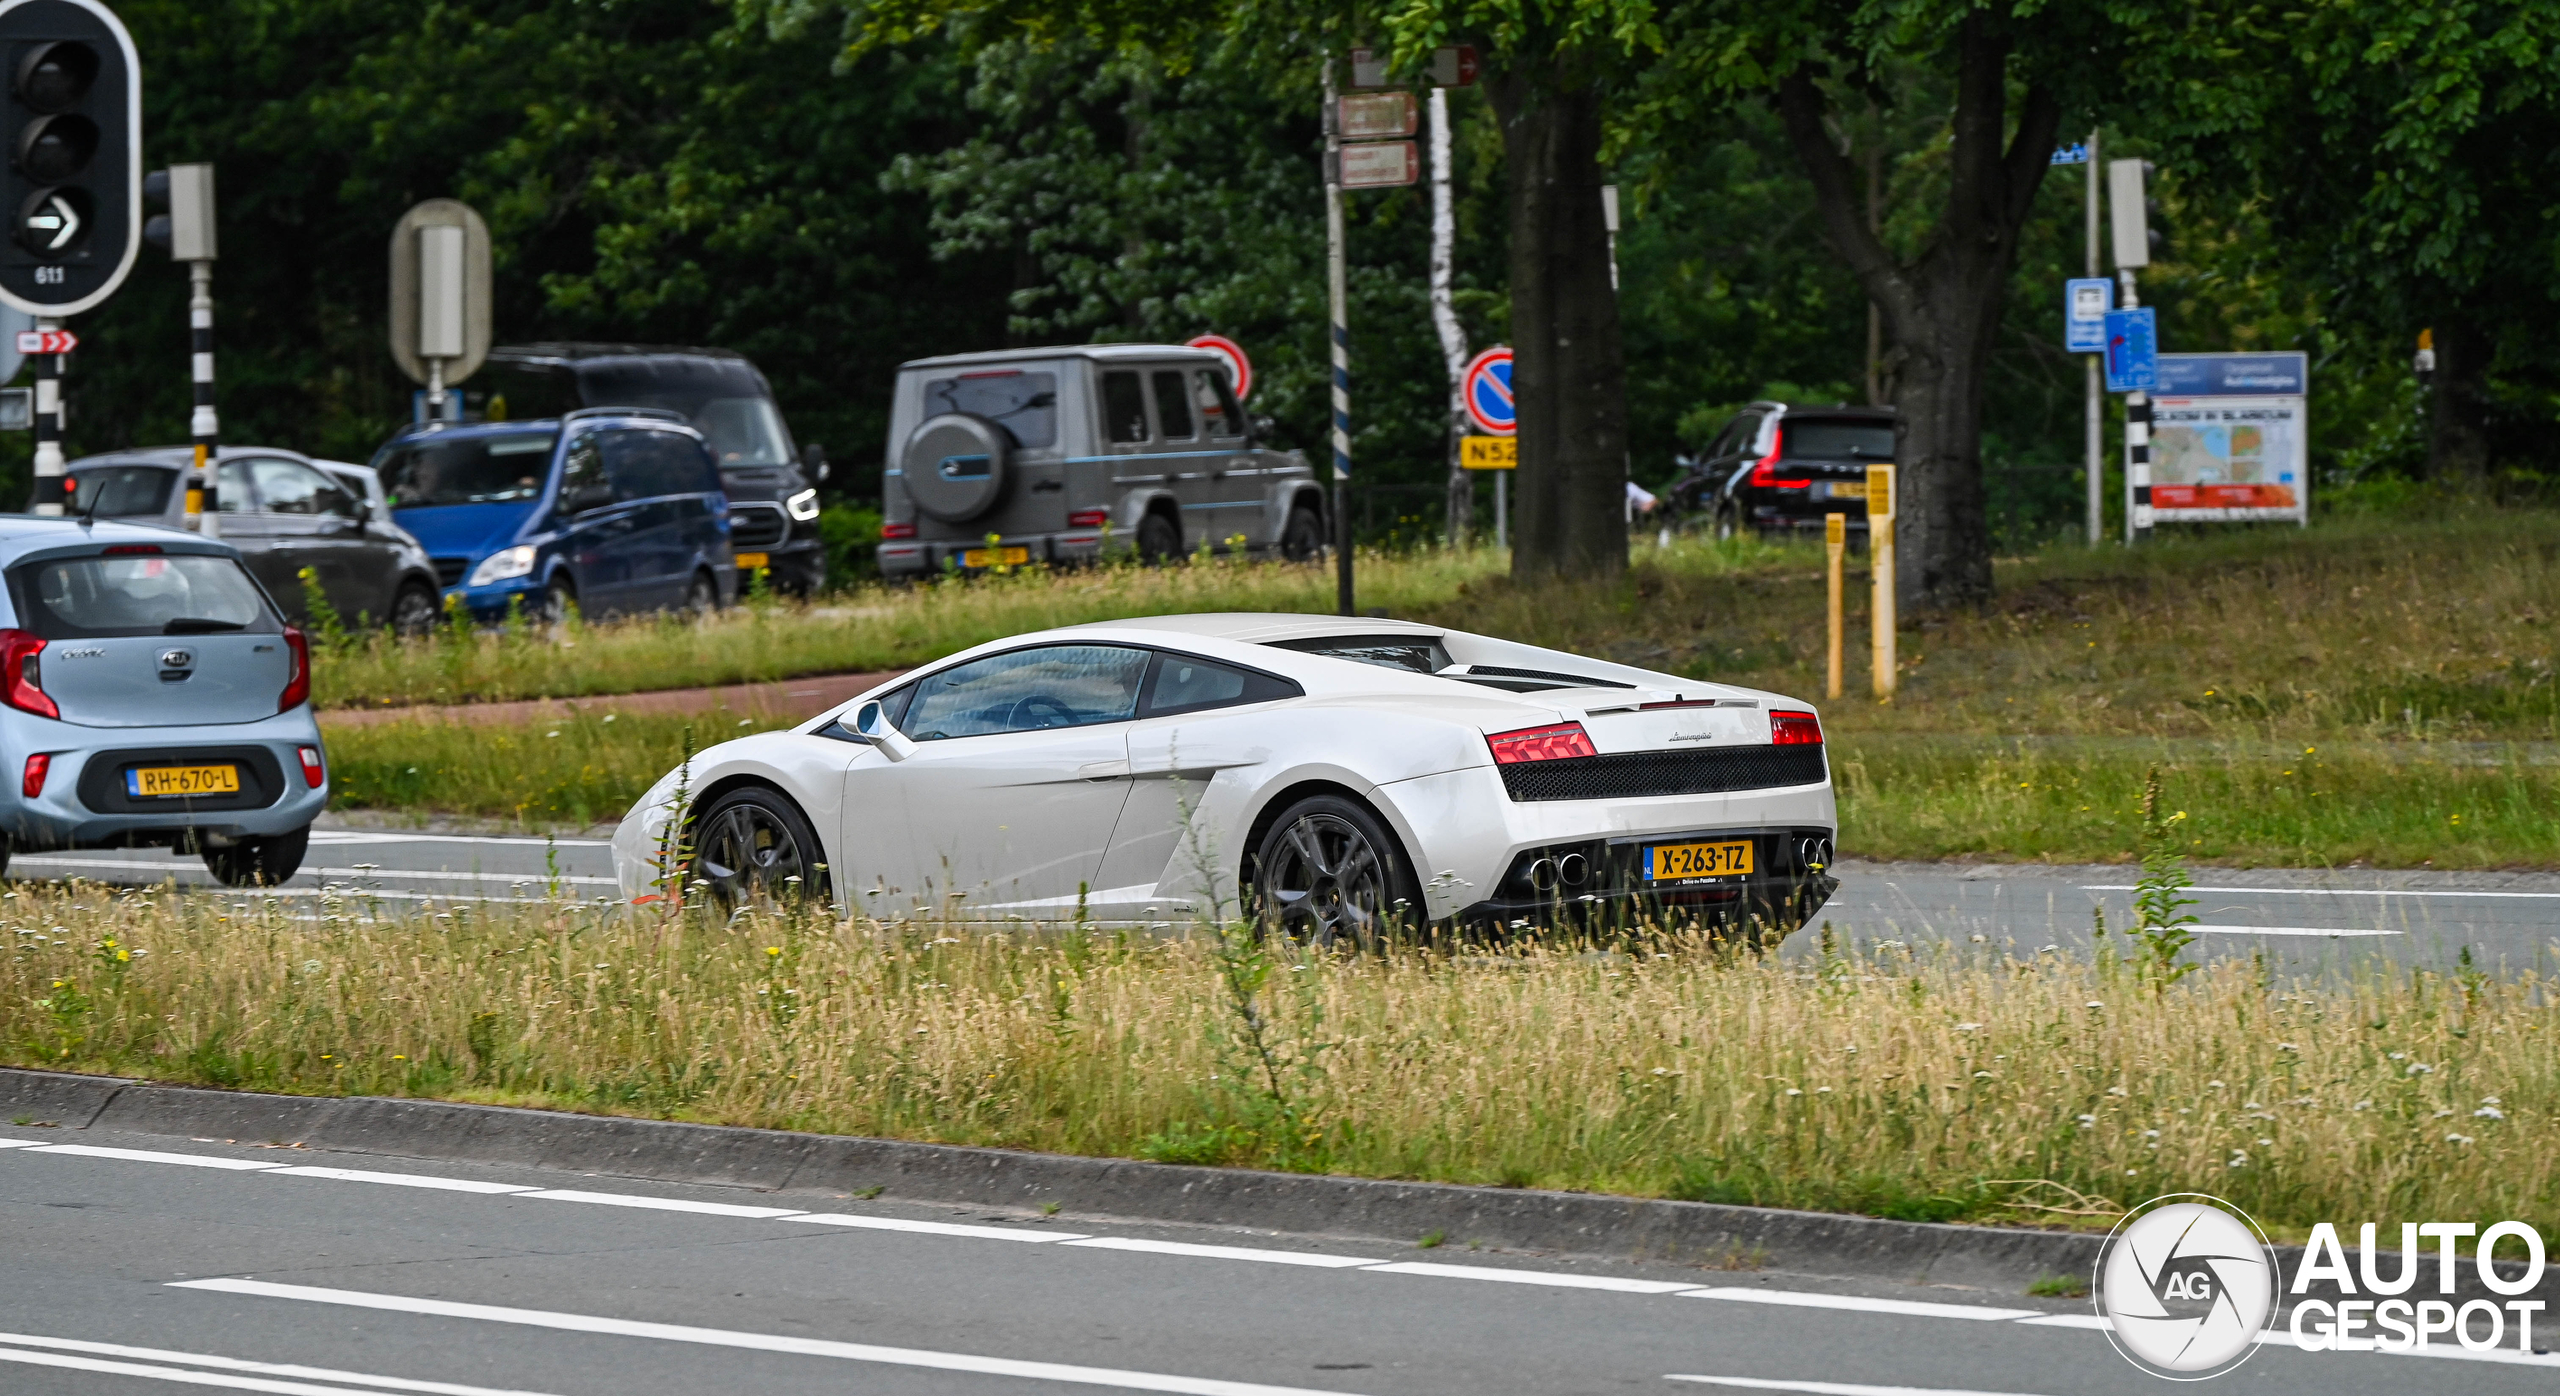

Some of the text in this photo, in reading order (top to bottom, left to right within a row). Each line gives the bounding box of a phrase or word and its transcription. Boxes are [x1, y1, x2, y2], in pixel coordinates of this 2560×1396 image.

[1471, 442, 1517, 461] N52
[144, 769, 233, 792] RH-670-L
[1662, 845, 1745, 874] X-263-TZ
